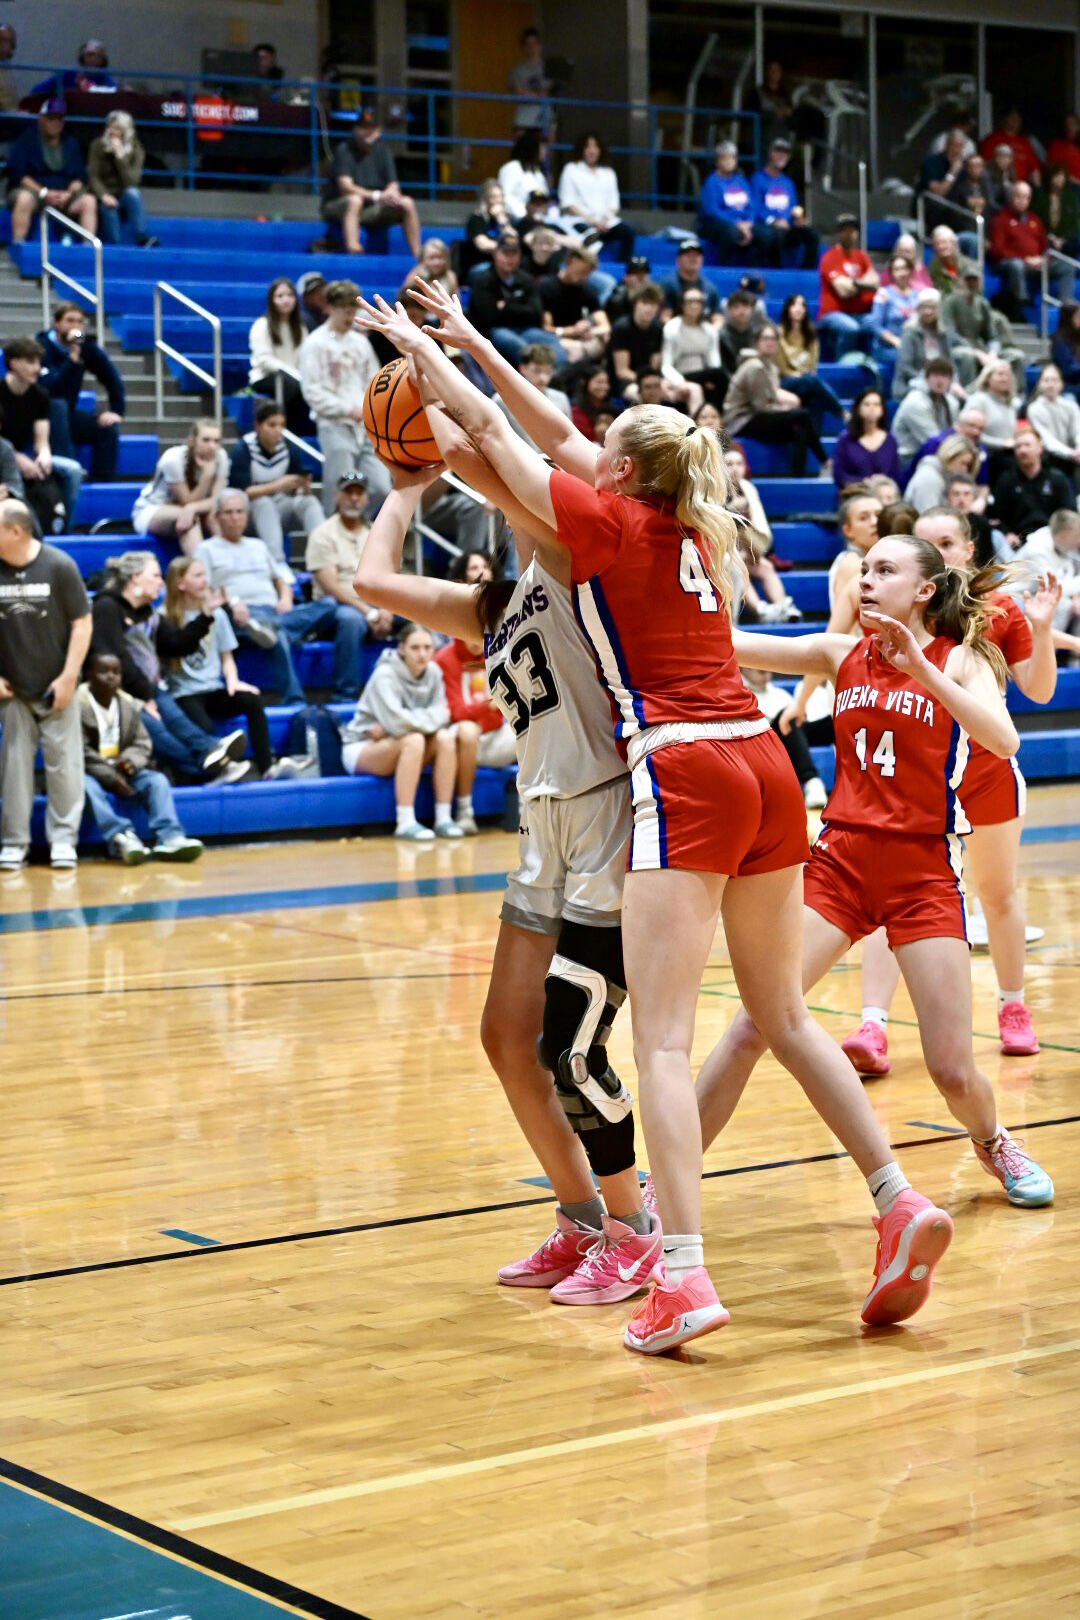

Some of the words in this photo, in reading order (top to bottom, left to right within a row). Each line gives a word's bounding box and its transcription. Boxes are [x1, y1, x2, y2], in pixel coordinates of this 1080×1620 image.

[677, 534, 719, 612] 4
[489, 628, 562, 740] 33
[835, 684, 879, 718] BUENA
[885, 690, 934, 727] VISTA
[854, 726, 897, 777] 14
